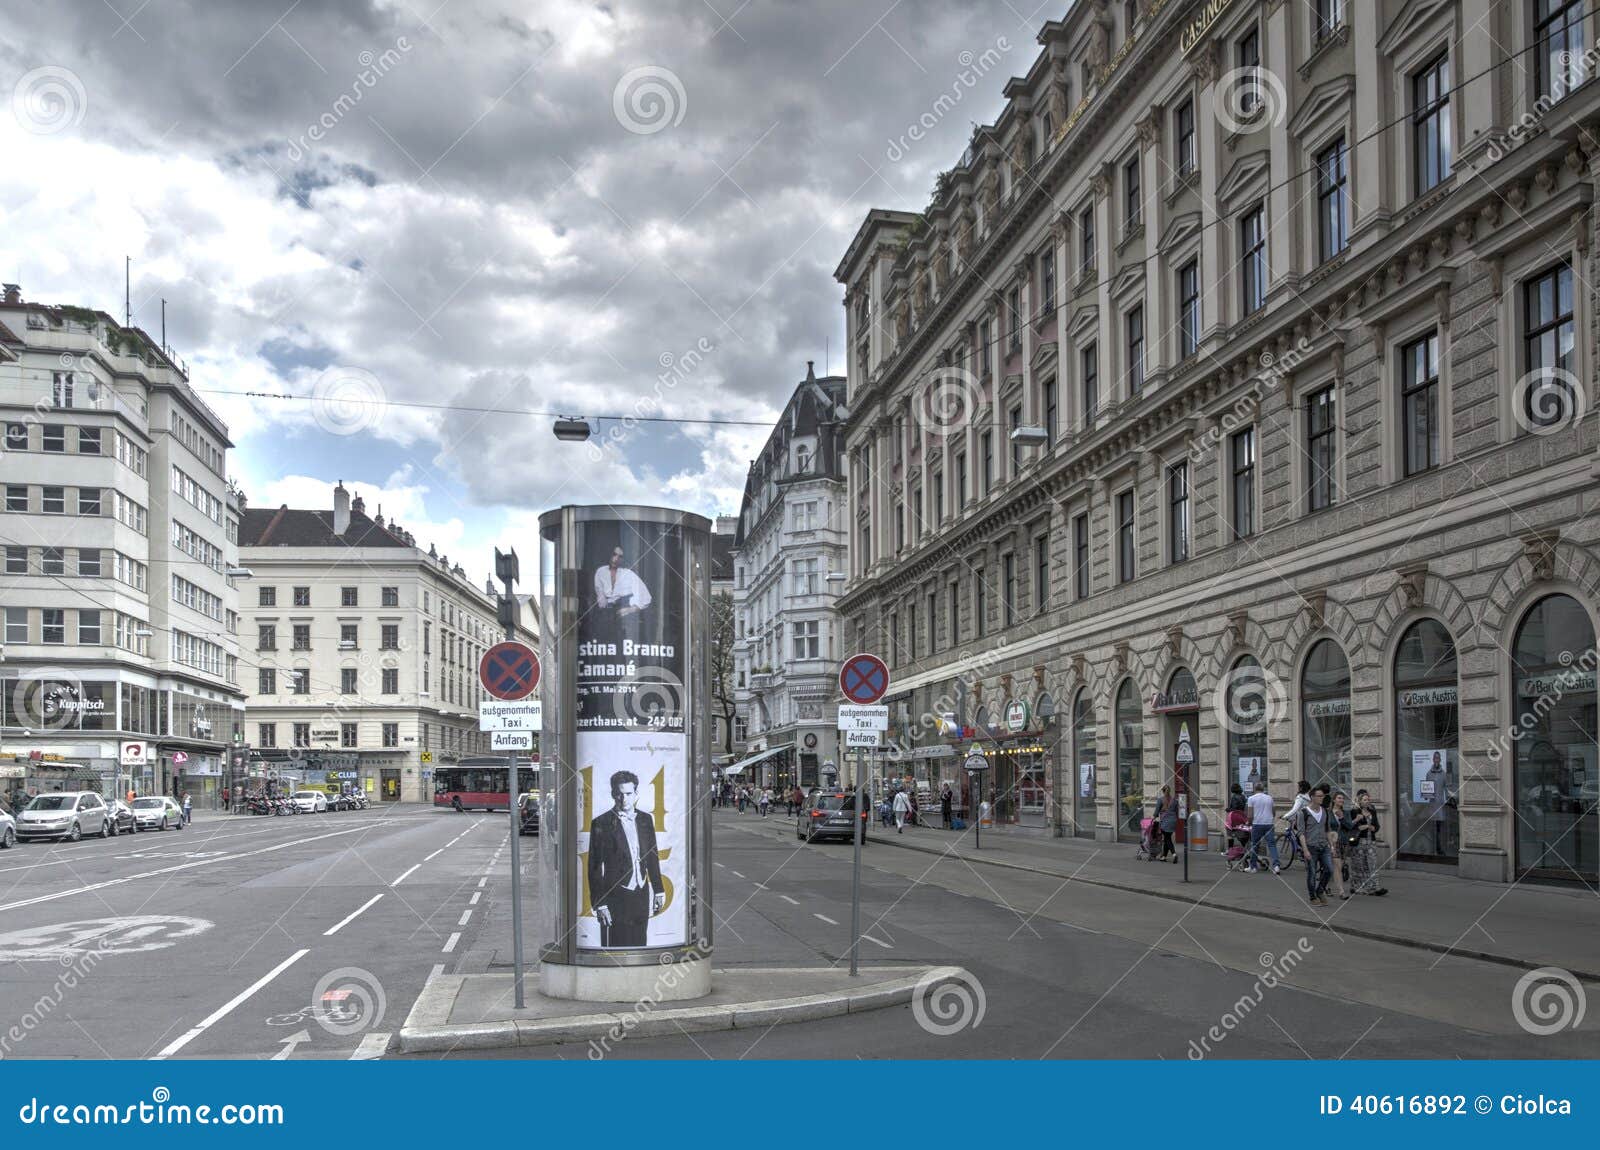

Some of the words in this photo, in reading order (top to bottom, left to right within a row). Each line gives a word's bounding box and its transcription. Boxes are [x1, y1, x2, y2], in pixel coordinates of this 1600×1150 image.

[1180, 0, 1228, 53] CASINO
[579, 640, 617, 656] stina
[622, 639, 675, 658] Branco
[618, 686, 637, 694] 2014
[59, 698, 104, 712] Kuppitsch
[482, 705, 541, 717] ausgenommen
[840, 708, 887, 719] ausgenommen
[501, 717, 522, 728] Taxi
[648, 716, 666, 727] 242
[856, 719, 872, 728] Taxi
[495, 733, 528, 747] Anfang
[850, 733, 876, 745] Anfang
